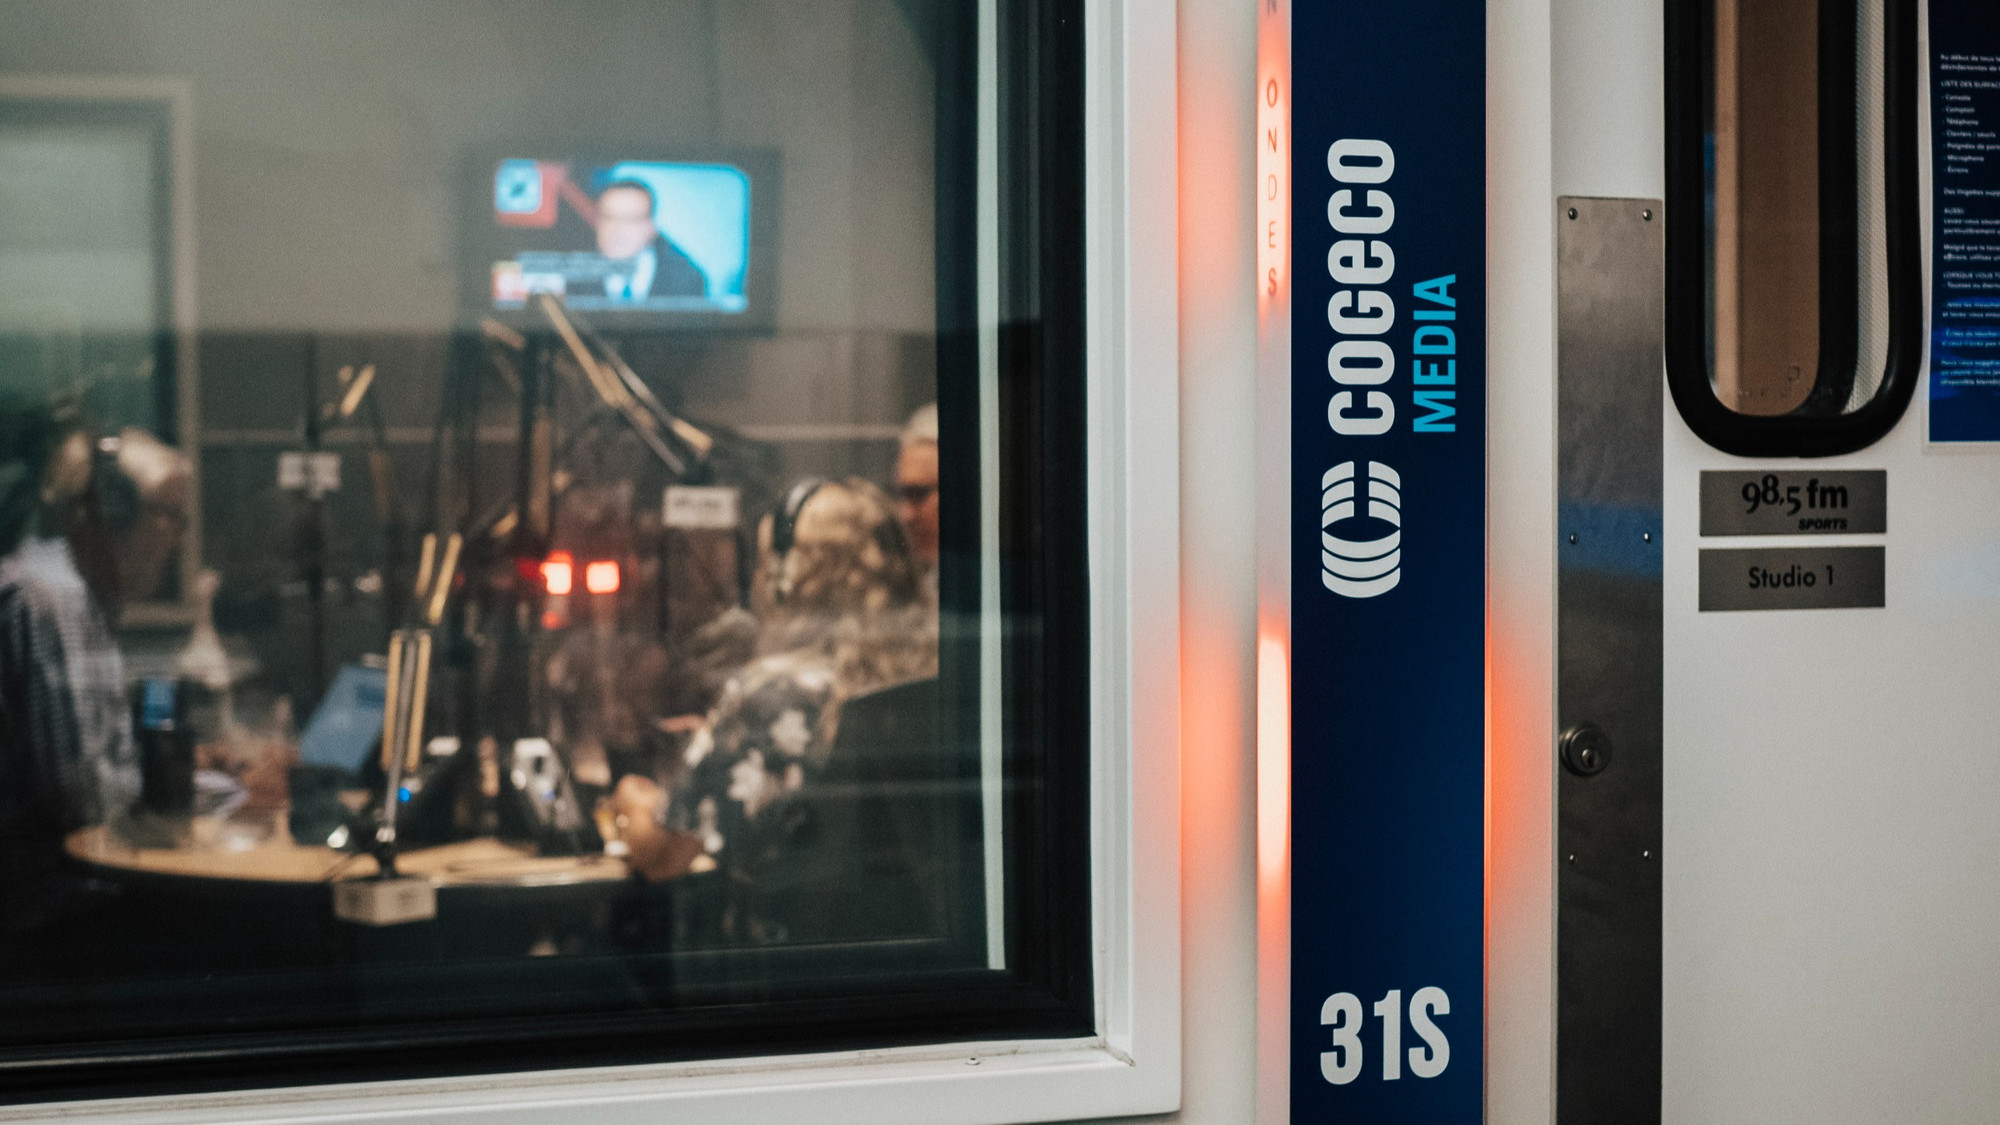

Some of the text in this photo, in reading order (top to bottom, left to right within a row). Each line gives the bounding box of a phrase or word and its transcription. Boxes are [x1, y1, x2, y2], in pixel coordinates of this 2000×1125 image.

[1413, 274, 1456, 432] MEDIA
[1806, 478, 1848, 509] fm
[1798, 518, 1848, 531] SPORTS
[1749, 565, 1834, 589] Studio 1
[1320, 986, 1450, 1085] 31S
